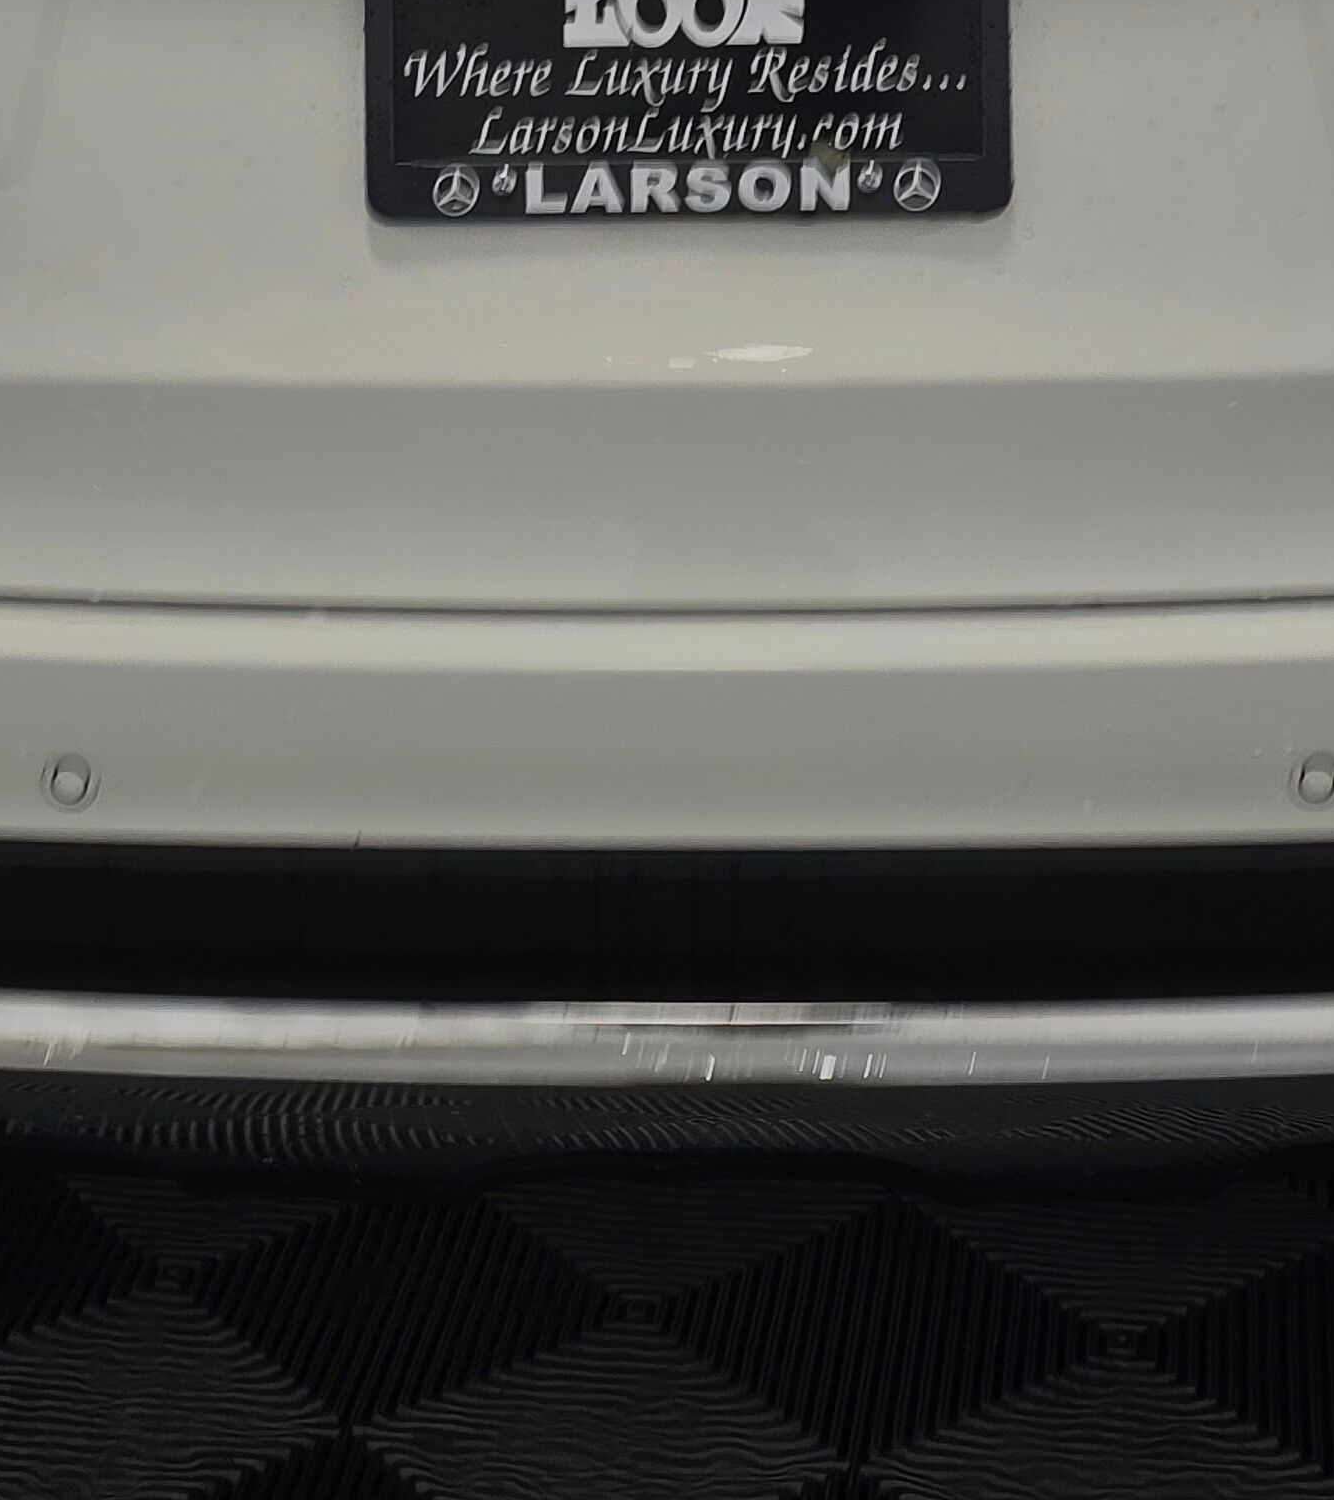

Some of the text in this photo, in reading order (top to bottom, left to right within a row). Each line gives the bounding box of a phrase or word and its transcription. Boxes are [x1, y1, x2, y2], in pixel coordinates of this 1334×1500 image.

[403, 37, 969, 112] Where Luxury Resides...
[468, 106, 905, 158] LarsonLuxury.com
[524, 161, 852, 214] LARSON
